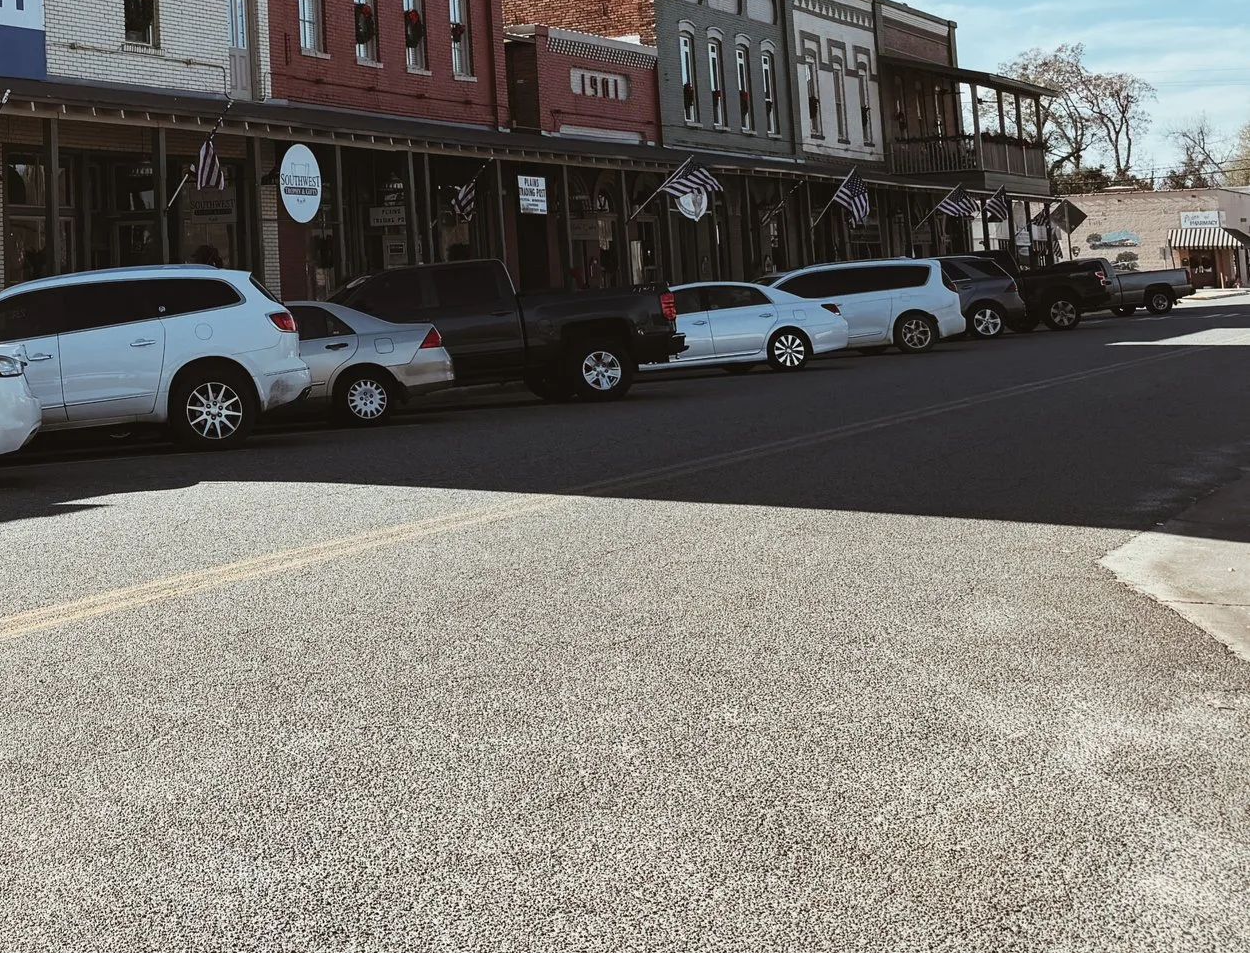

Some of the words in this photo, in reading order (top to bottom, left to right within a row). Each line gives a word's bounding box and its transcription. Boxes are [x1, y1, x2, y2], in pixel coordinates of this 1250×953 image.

[581, 74, 619, 99] 1901
[281, 173, 320, 188] SOUTHWEST
[524, 178, 539, 187] PLAINS
[190, 198, 235, 209] SOUTHWEST
